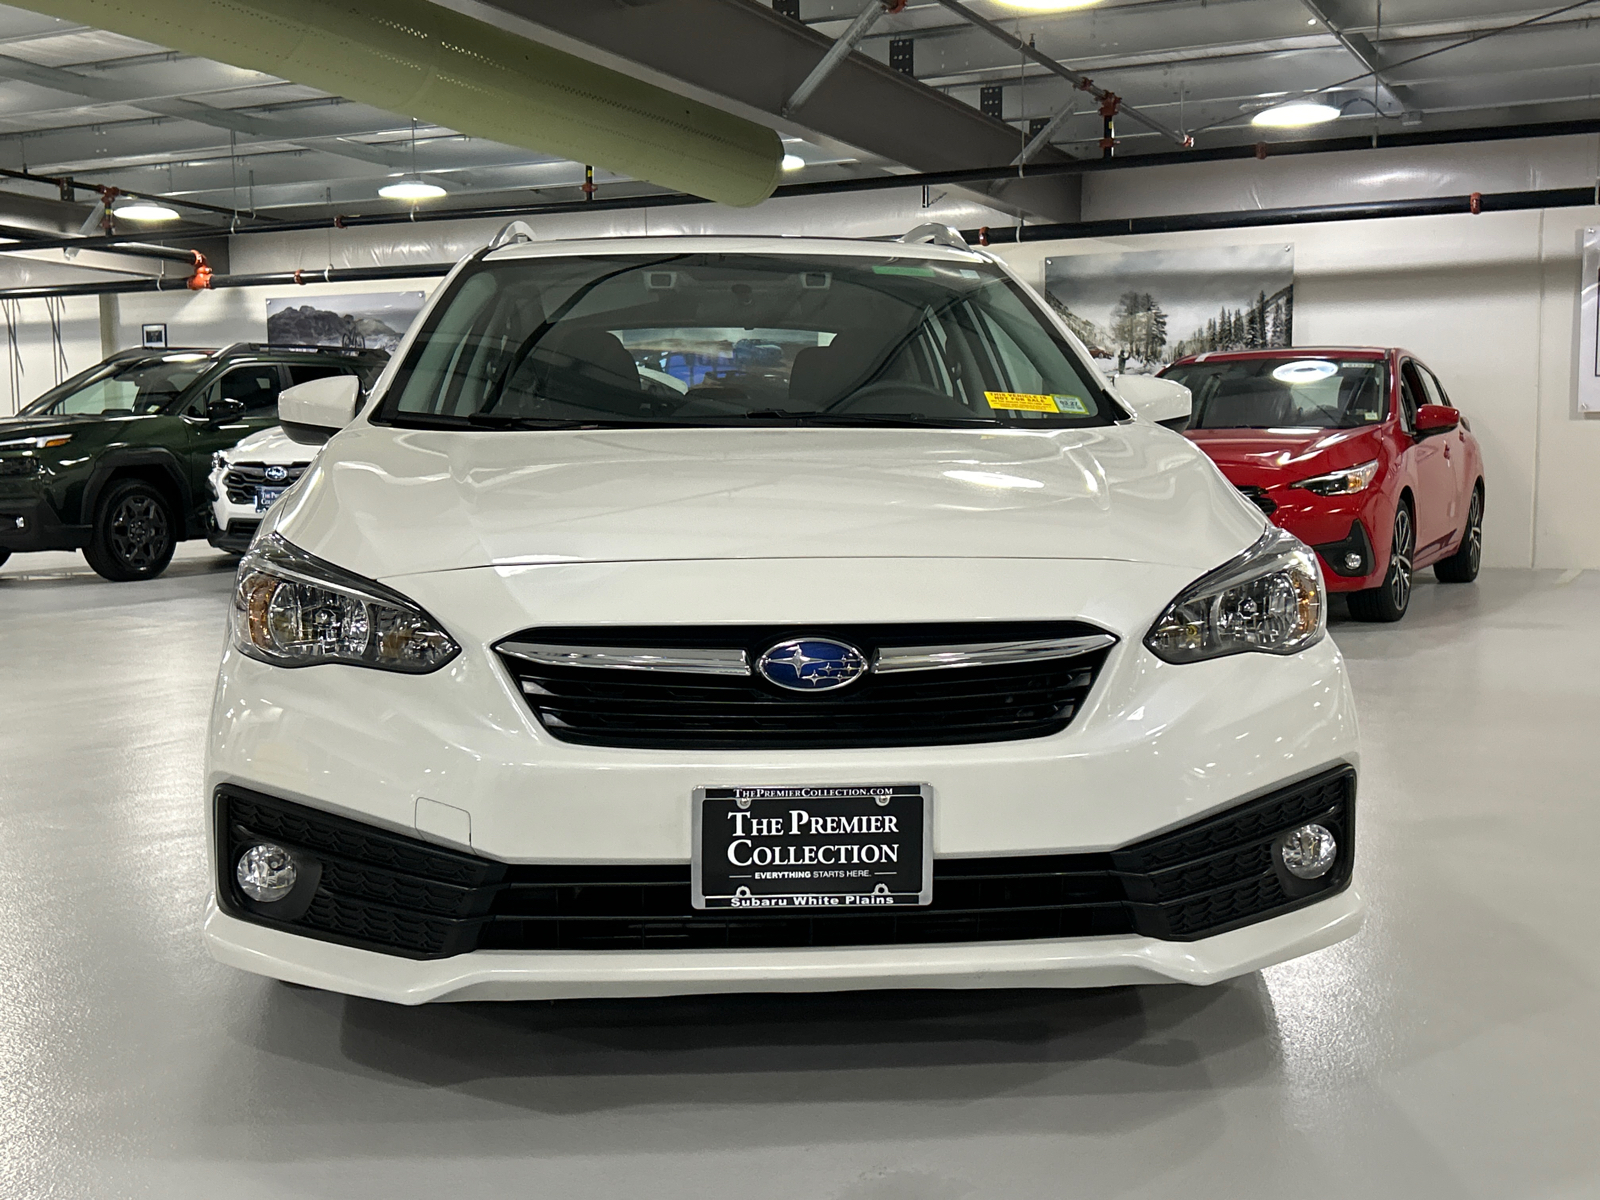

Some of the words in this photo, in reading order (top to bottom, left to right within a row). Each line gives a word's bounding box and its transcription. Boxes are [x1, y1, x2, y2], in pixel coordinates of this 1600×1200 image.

[755, 871, 811, 879] EVERYTHING
[813, 870, 845, 878] STARTS
[731, 896, 787, 907] Subaru
[793, 895, 839, 906] White
[848, 894, 894, 905] Plains
